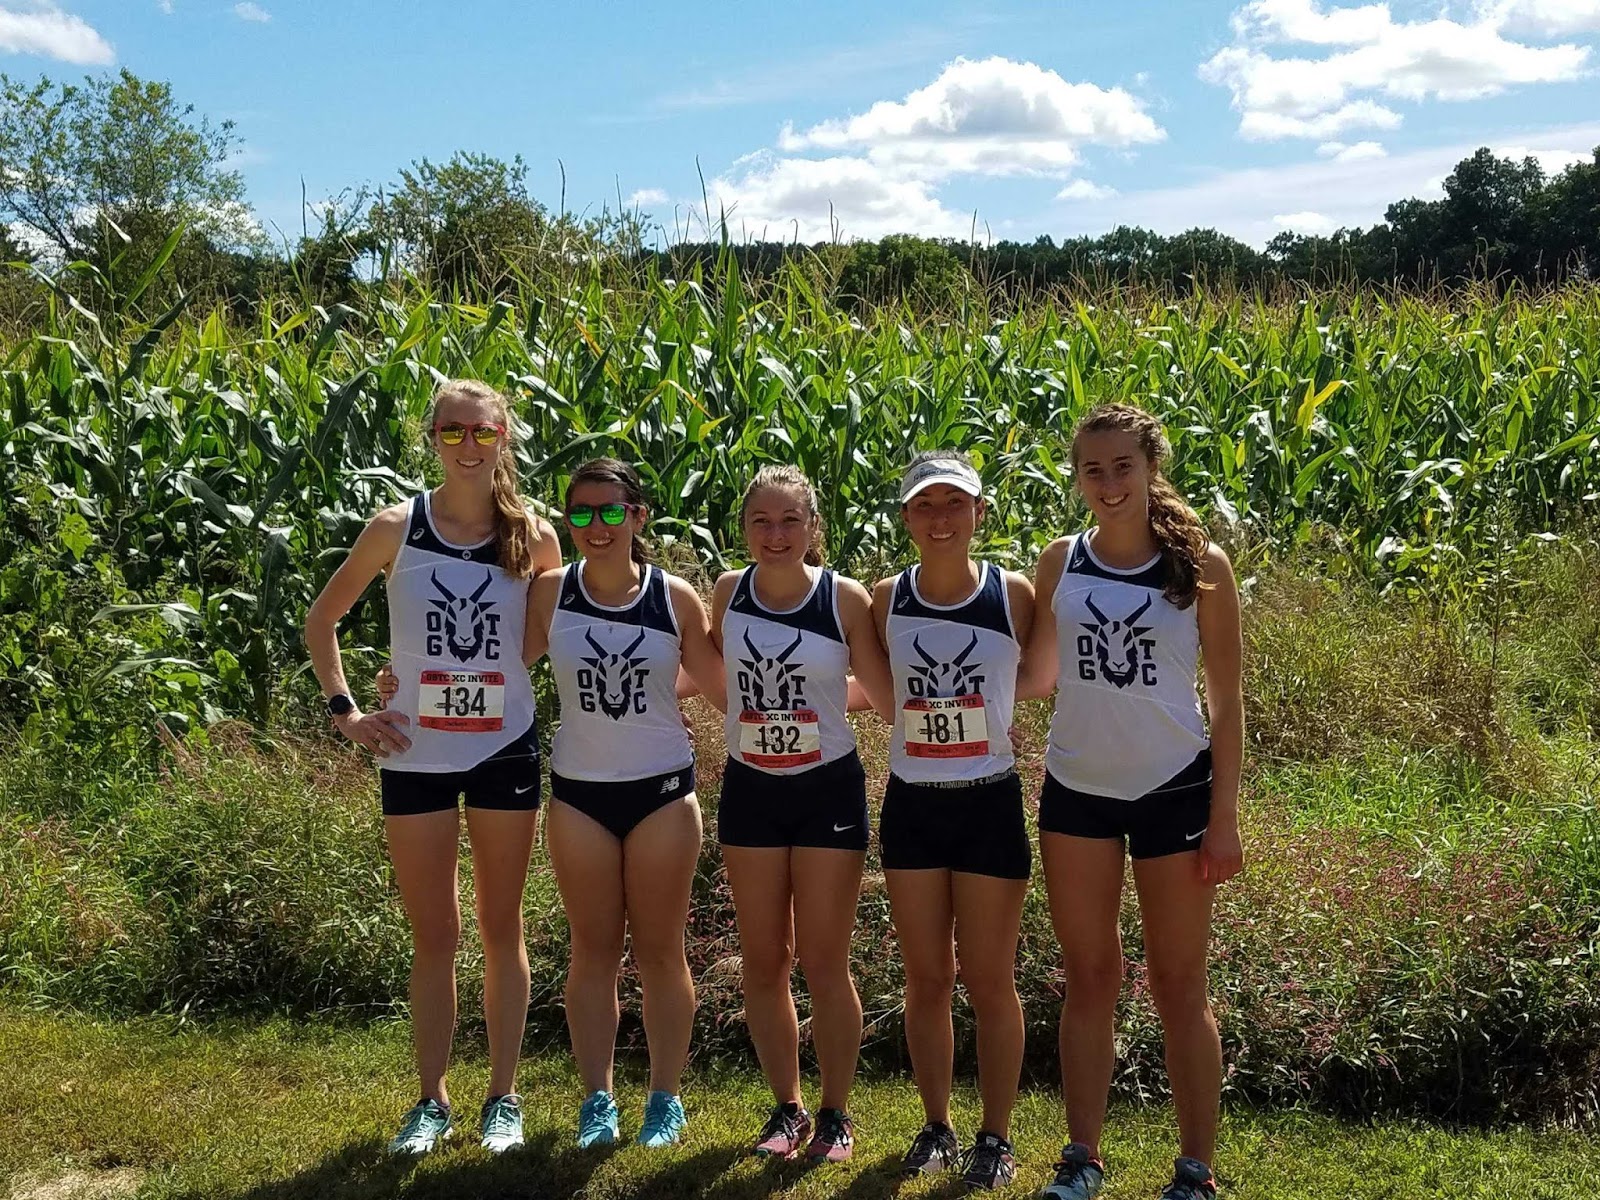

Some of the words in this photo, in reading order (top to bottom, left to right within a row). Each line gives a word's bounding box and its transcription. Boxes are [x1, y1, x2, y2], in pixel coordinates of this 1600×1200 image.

[451, 674, 466, 682] XC
[467, 674, 499, 683] INVITE
[442, 686, 487, 717] 134
[928, 701, 943, 709] XC
[944, 697, 977, 709] INVITE
[766, 713, 780, 721] XC
[923, 711, 965, 744] 181
[757, 725, 802, 754] 132
